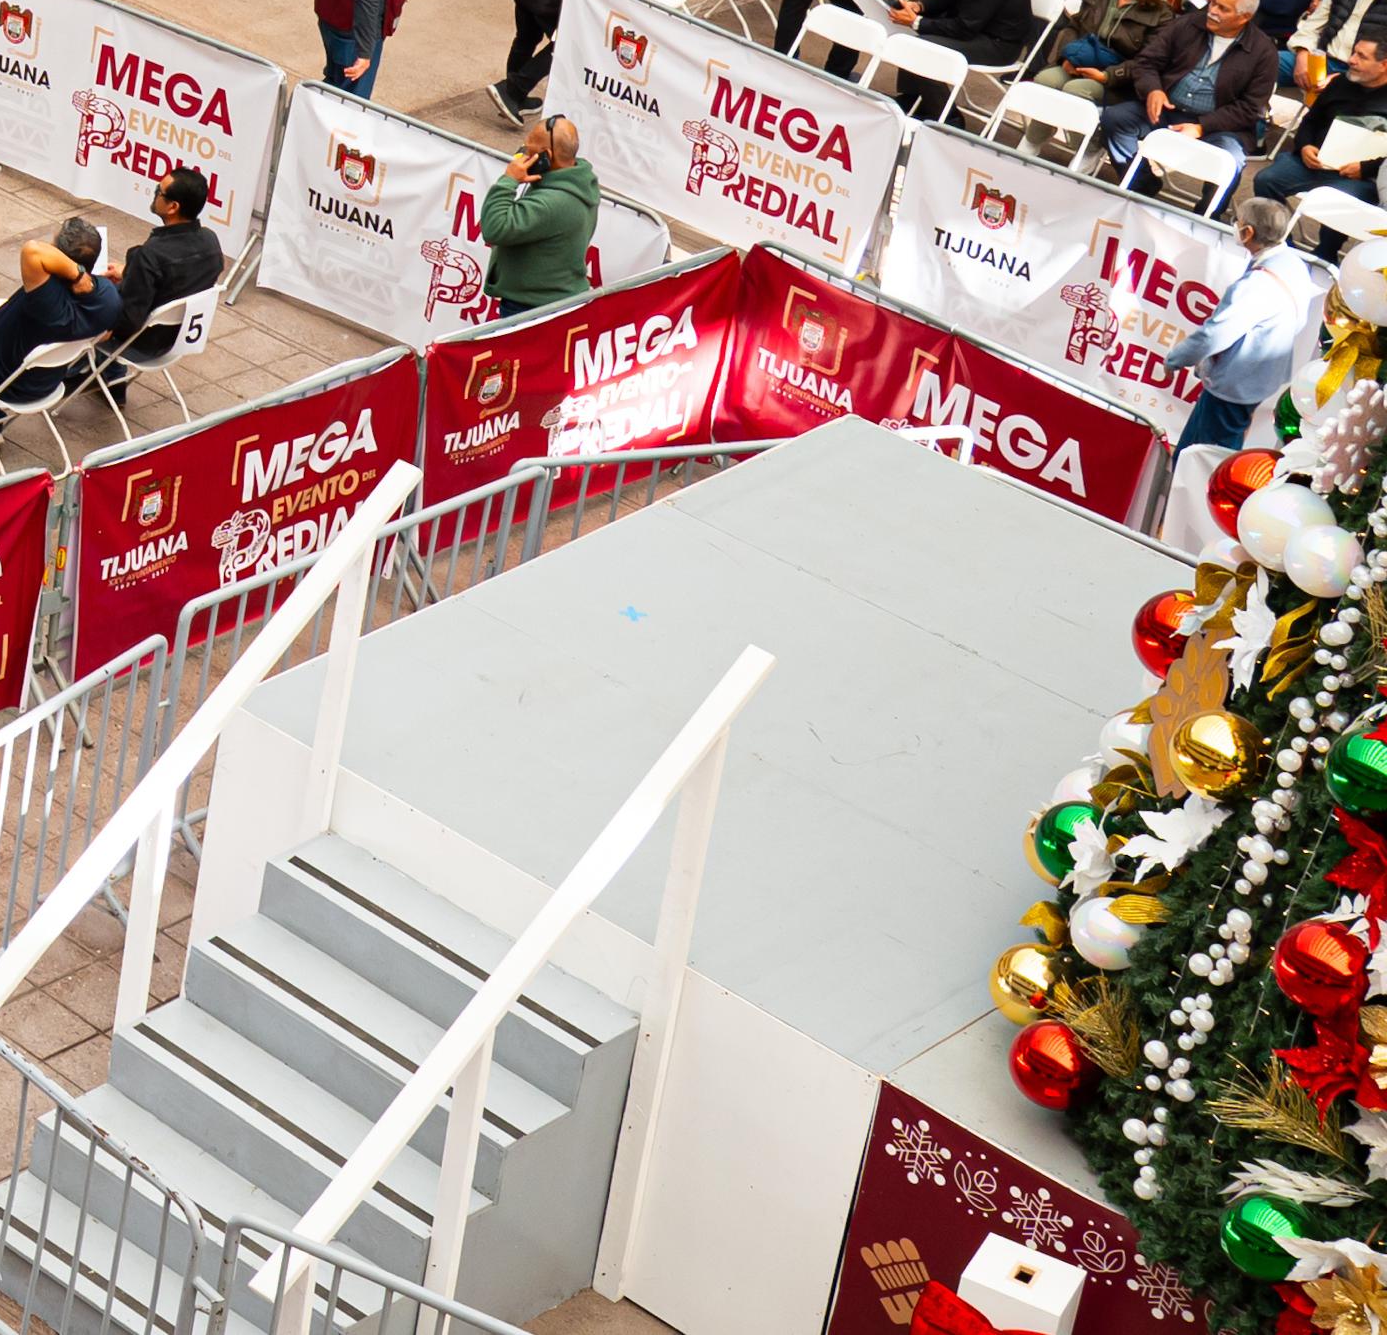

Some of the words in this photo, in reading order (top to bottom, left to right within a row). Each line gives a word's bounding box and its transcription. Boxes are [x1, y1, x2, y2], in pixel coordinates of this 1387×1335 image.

[95, 43, 233, 137] MEGA
[582, 68, 661, 118] TIJUANA
[71, 89, 223, 208] PREDIL
[128, 109, 215, 161] EVENTO
[218, 148, 232, 163] DEL
[709, 77, 854, 173] MEGA
[683, 119, 839, 246] PREDIAL
[742, 142, 833, 197] EVENTO
[834, 183, 851, 199] DEL
[308, 188, 395, 241] TIJUANA
[743, 214, 787, 241] 2026
[933, 227, 1032, 283] TIJUANA
[1100, 236, 1221, 325] MEG
[185, 313, 204, 345] 5
[573, 305, 700, 389] MEGA
[756, 346, 854, 412] TIJUANA
[1117, 387, 1175, 414] 2026
[242, 409, 378, 504] MEGA
[444, 410, 520, 454] TIJUANA
[911, 366, 1088, 499] MEGA
[272, 475, 359, 526] EVENTO
[361, 468, 377, 481] DEL
[101, 531, 188, 578] TIJUANA
[211, 502, 364, 590] PREDIA
